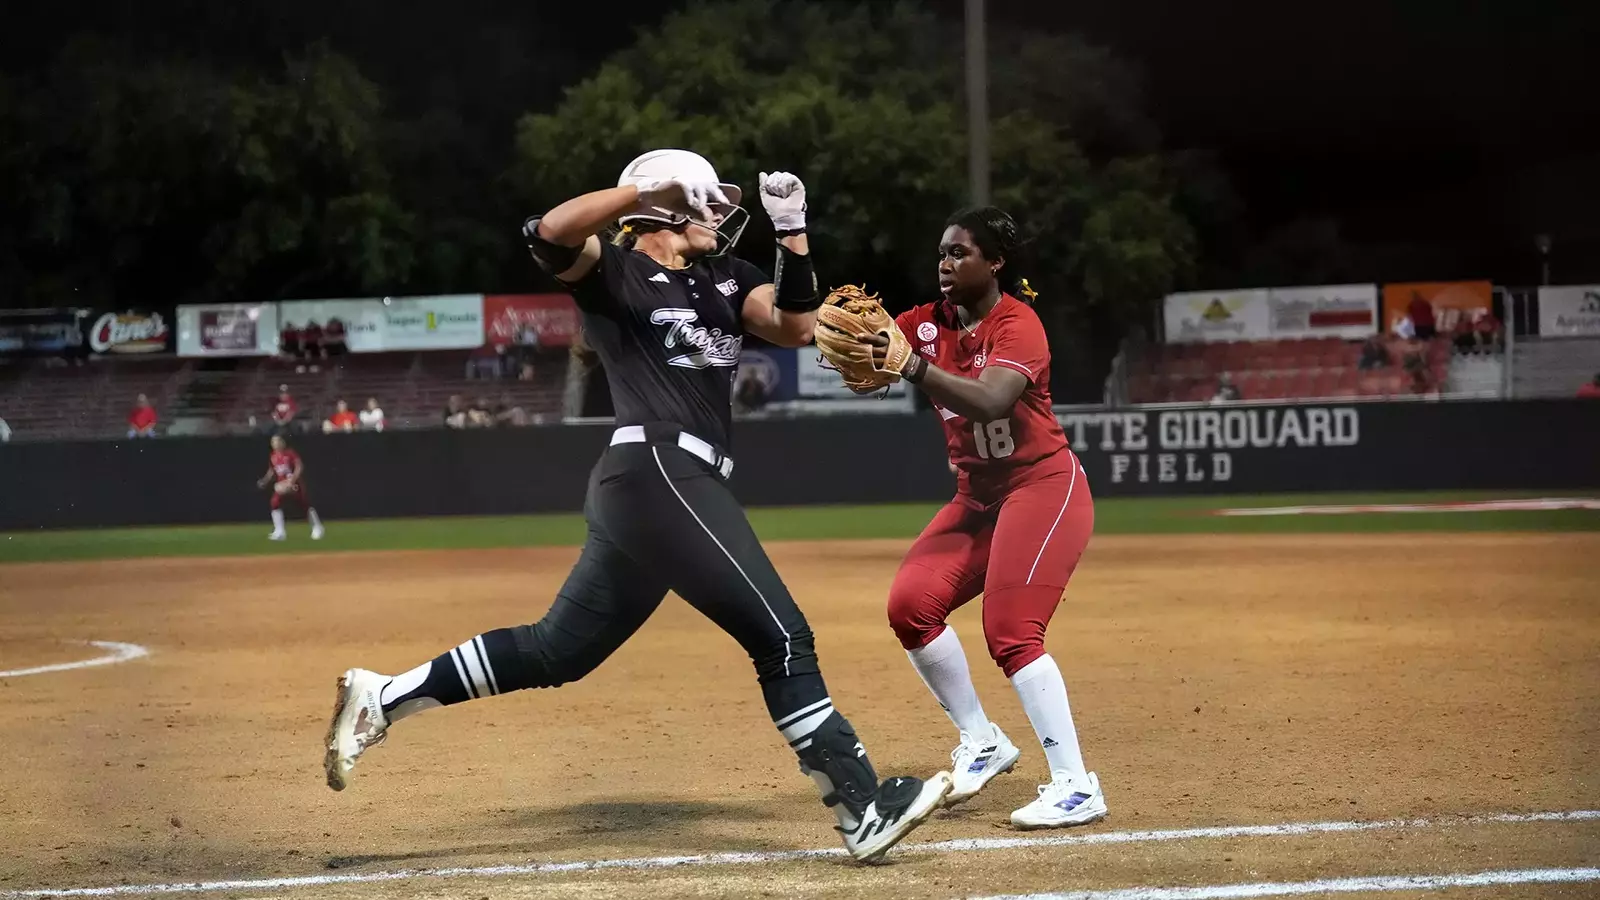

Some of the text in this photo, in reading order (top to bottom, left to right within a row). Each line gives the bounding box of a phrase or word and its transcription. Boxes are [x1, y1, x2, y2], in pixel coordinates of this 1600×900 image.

[973, 418, 1014, 458] 18
[1057, 408, 1359, 451] TTE GIROUARD
[1110, 453, 1232, 483] FIELD
